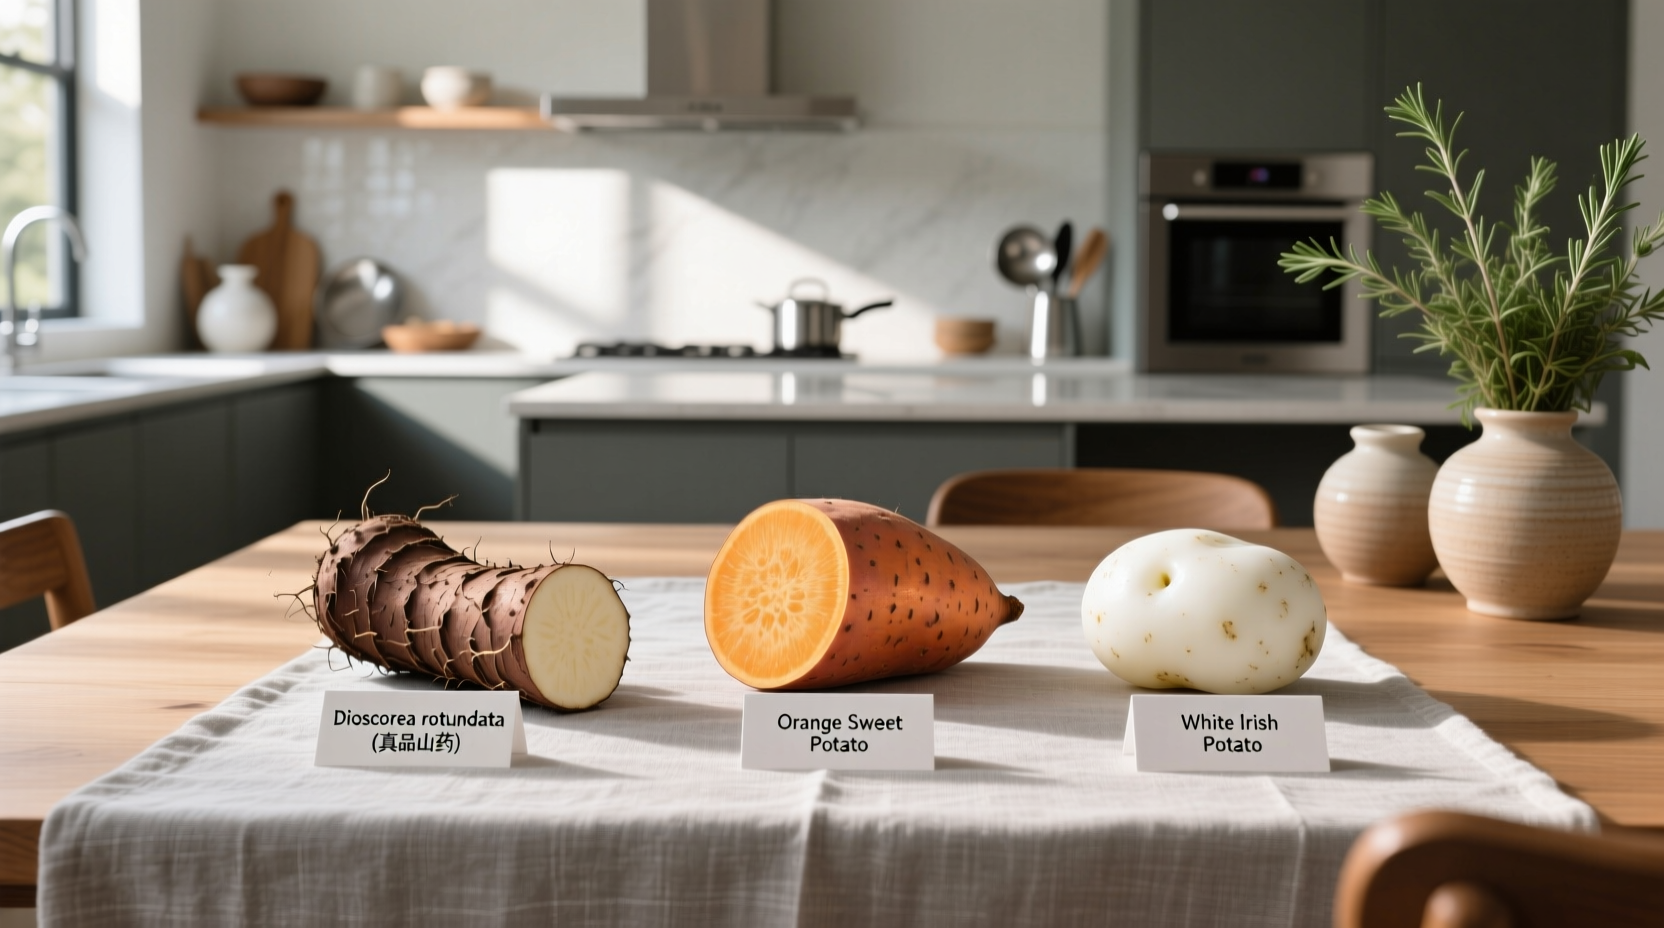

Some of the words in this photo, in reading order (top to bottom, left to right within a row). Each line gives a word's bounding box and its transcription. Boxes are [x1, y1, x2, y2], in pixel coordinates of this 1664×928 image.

[333, 709, 416, 727] Dioscorea
[421, 709, 505, 728] rotundata
[777, 713, 842, 735] Orange
[848, 713, 904, 731] Sweet
[1180, 713, 1235, 731] White
[1240, 713, 1279, 731] Irish
[810, 735, 869, 753] Potato
[1203, 735, 1263, 753] Potato
